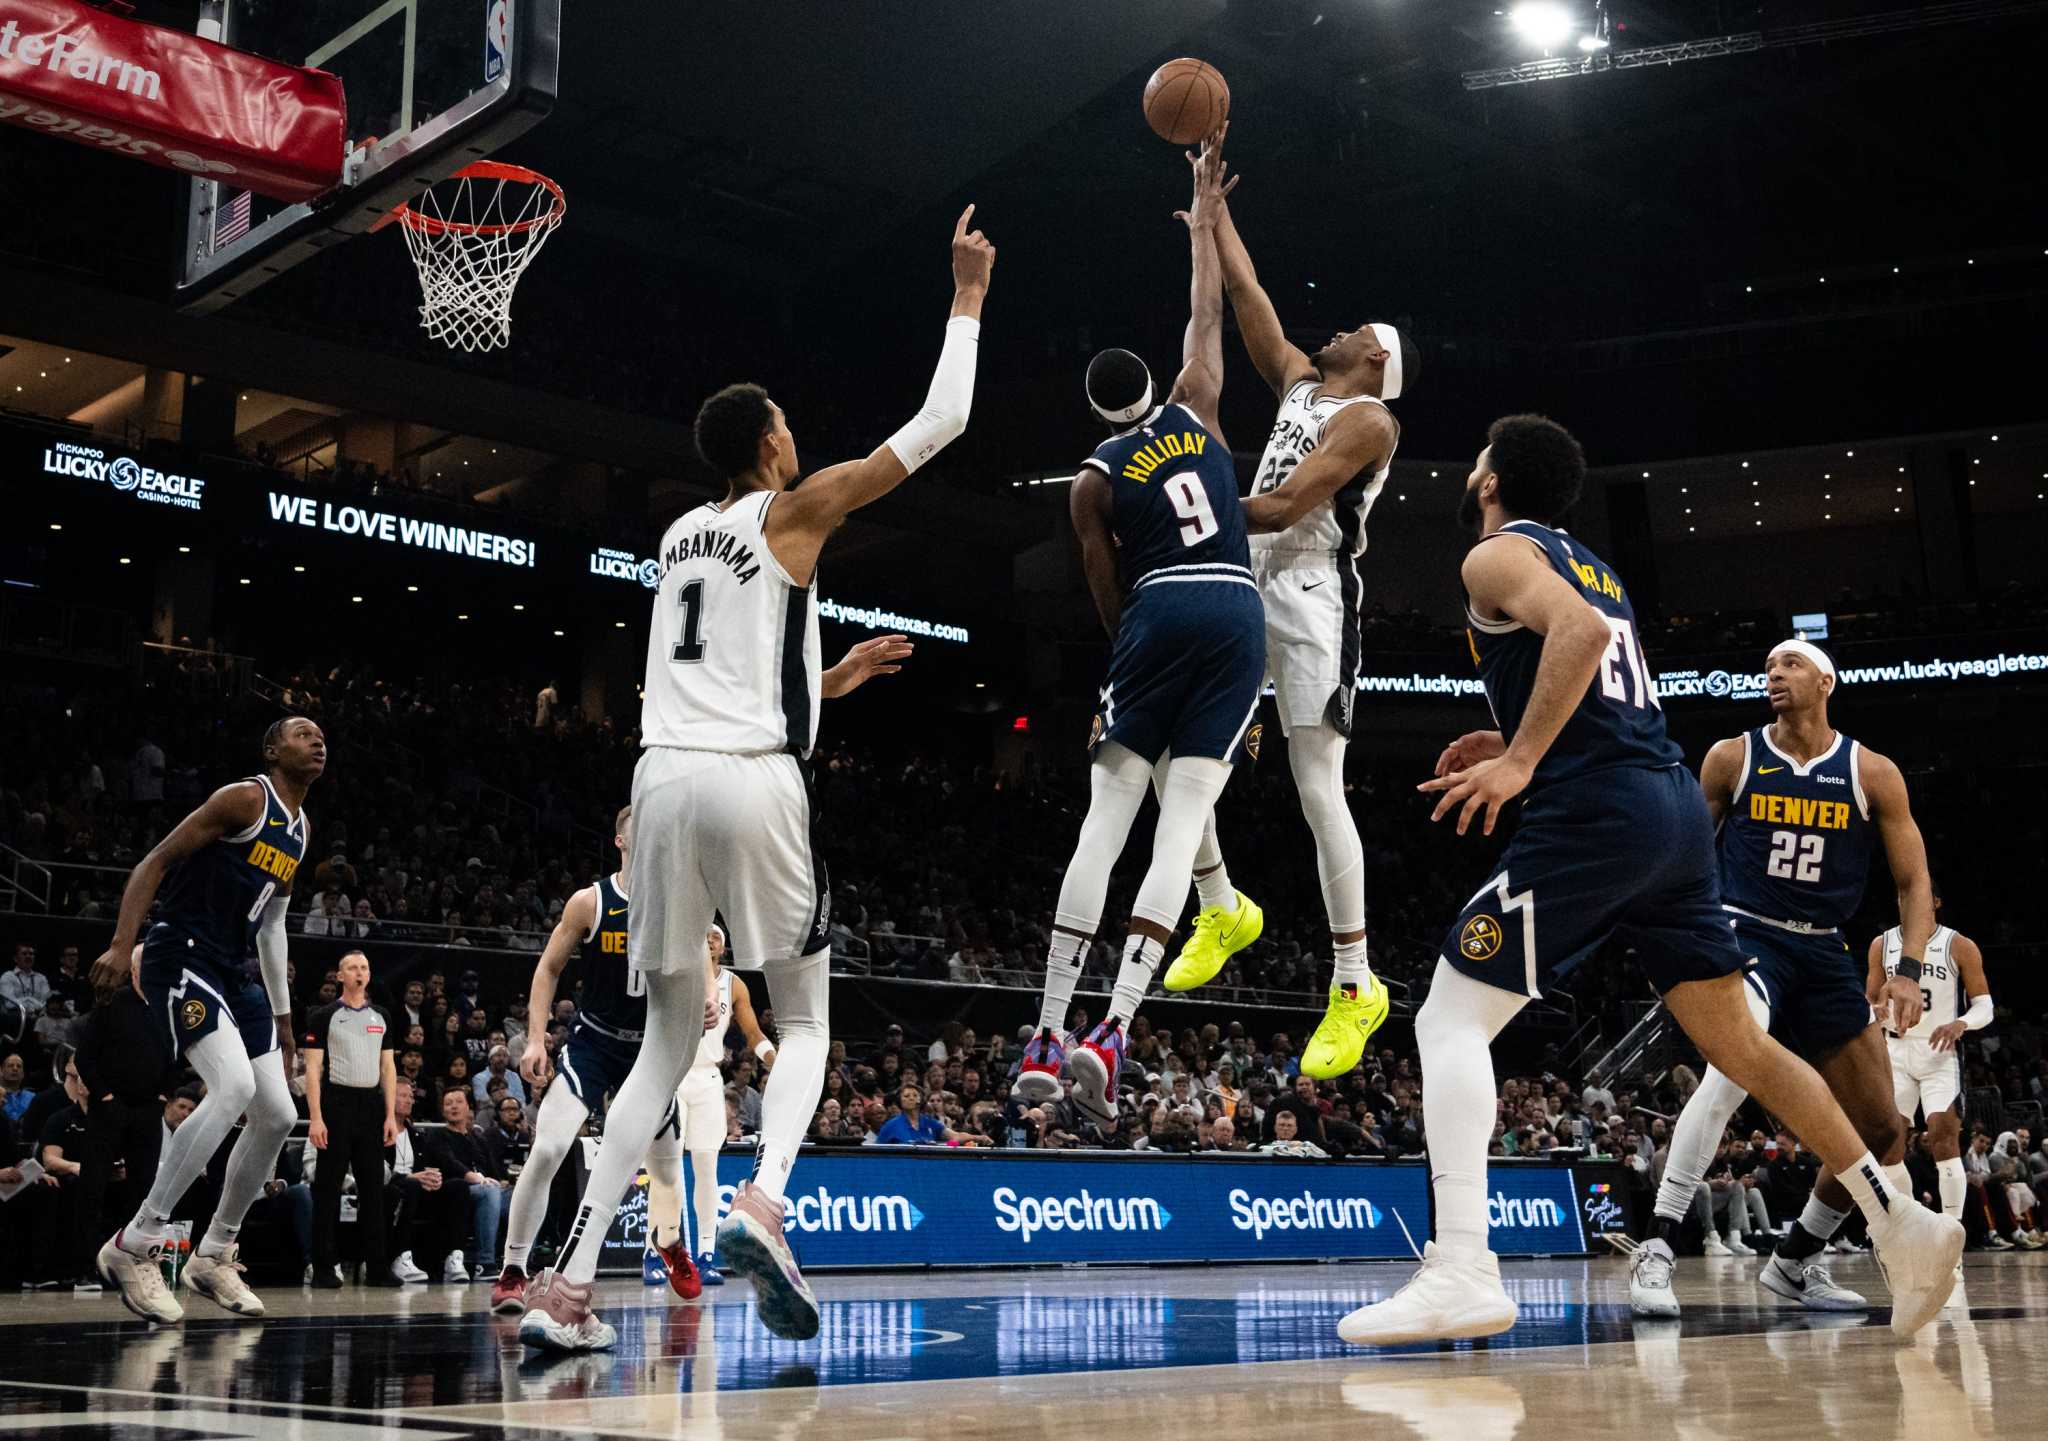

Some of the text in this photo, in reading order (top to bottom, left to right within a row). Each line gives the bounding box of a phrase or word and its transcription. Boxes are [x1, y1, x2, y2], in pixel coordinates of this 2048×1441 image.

[44, 449, 203, 499] LUCKY EAGLE
[56, 442, 104, 459] KICKAPOO
[1122, 431, 1207, 484] HOLIDAY
[269, 492, 535, 567] WE LOVE WINNERS!
[1163, 471, 1219, 547] 9
[590, 553, 640, 581] LUCKY
[668, 577, 708, 665] 1
[1653, 679, 1705, 697] LUCKY
[1659, 670, 1699, 680] KICKAPOO
[1816, 774, 1846, 785] ibotta
[1750, 793, 1850, 830] DENVER
[1767, 830, 1825, 883] 22
[247, 881, 276, 922] 8
[601, 931, 628, 954] DE
[717, 1185, 912, 1232] Sectrum
[993, 1187, 1162, 1243] Spectrum
[1229, 1189, 1375, 1240] Spectrum
